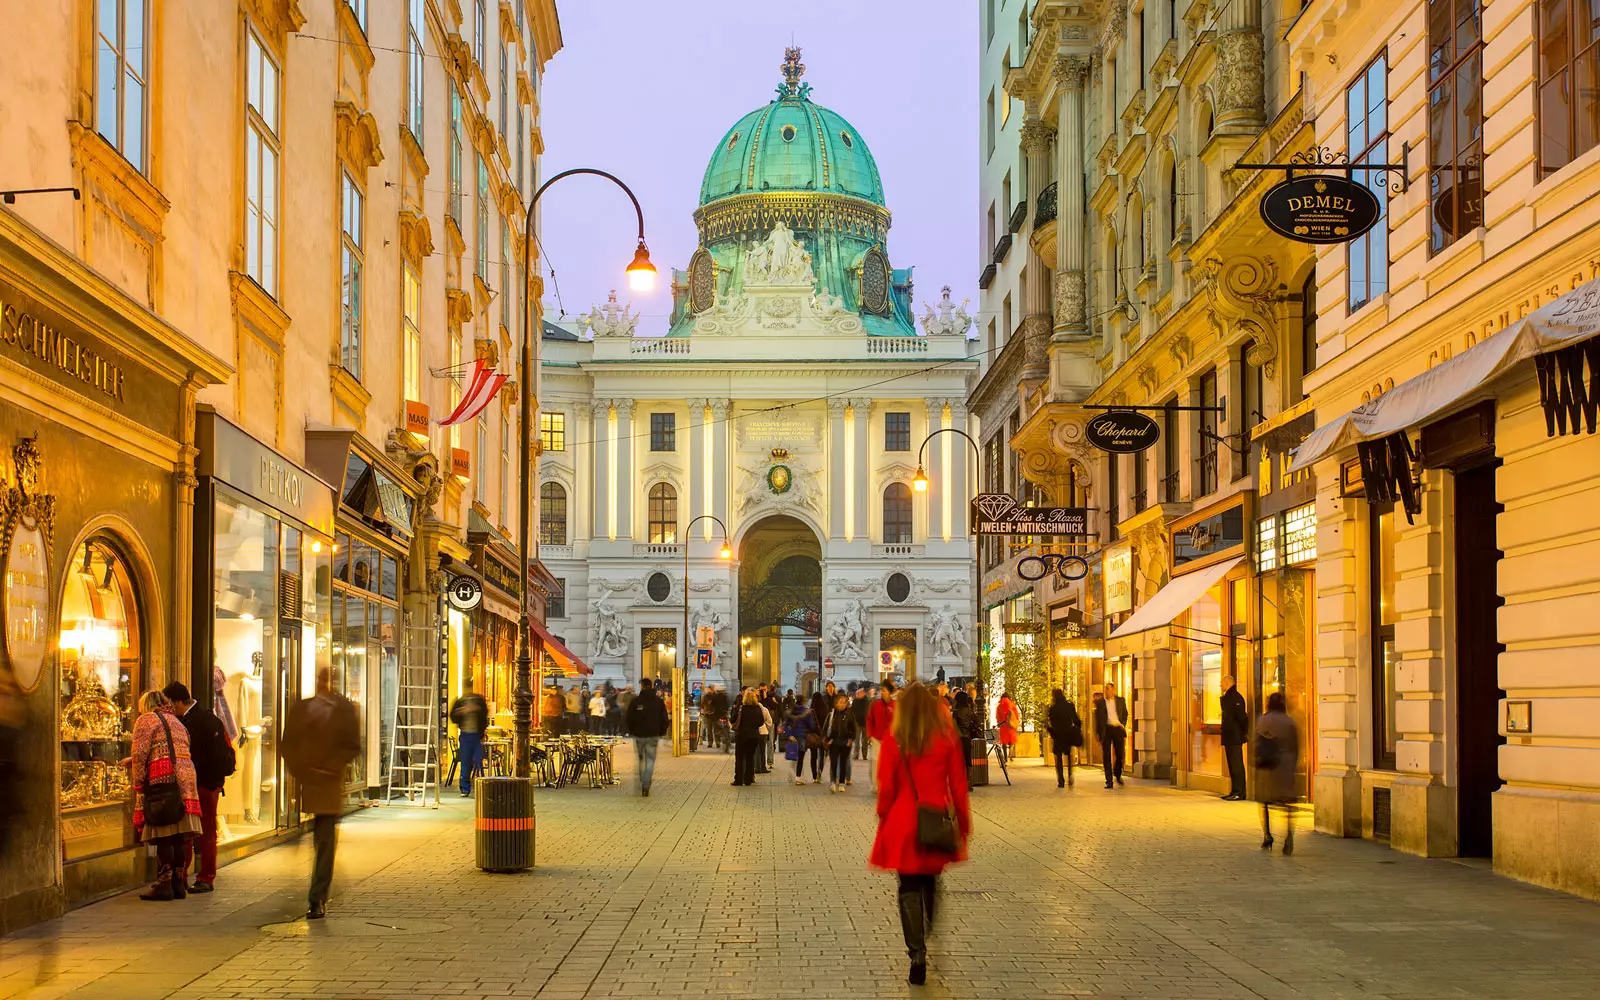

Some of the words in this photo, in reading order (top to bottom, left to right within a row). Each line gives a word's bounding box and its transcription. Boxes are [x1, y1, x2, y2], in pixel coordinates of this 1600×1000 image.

[1287, 195, 1356, 212] DEMEL
[1093, 420, 1152, 440] Chopard
[1007, 507, 1032, 522] Kiss
[1036, 512, 1045, 522] &
[1016, 522, 1084, 533] ANTIKSCHMUCK
